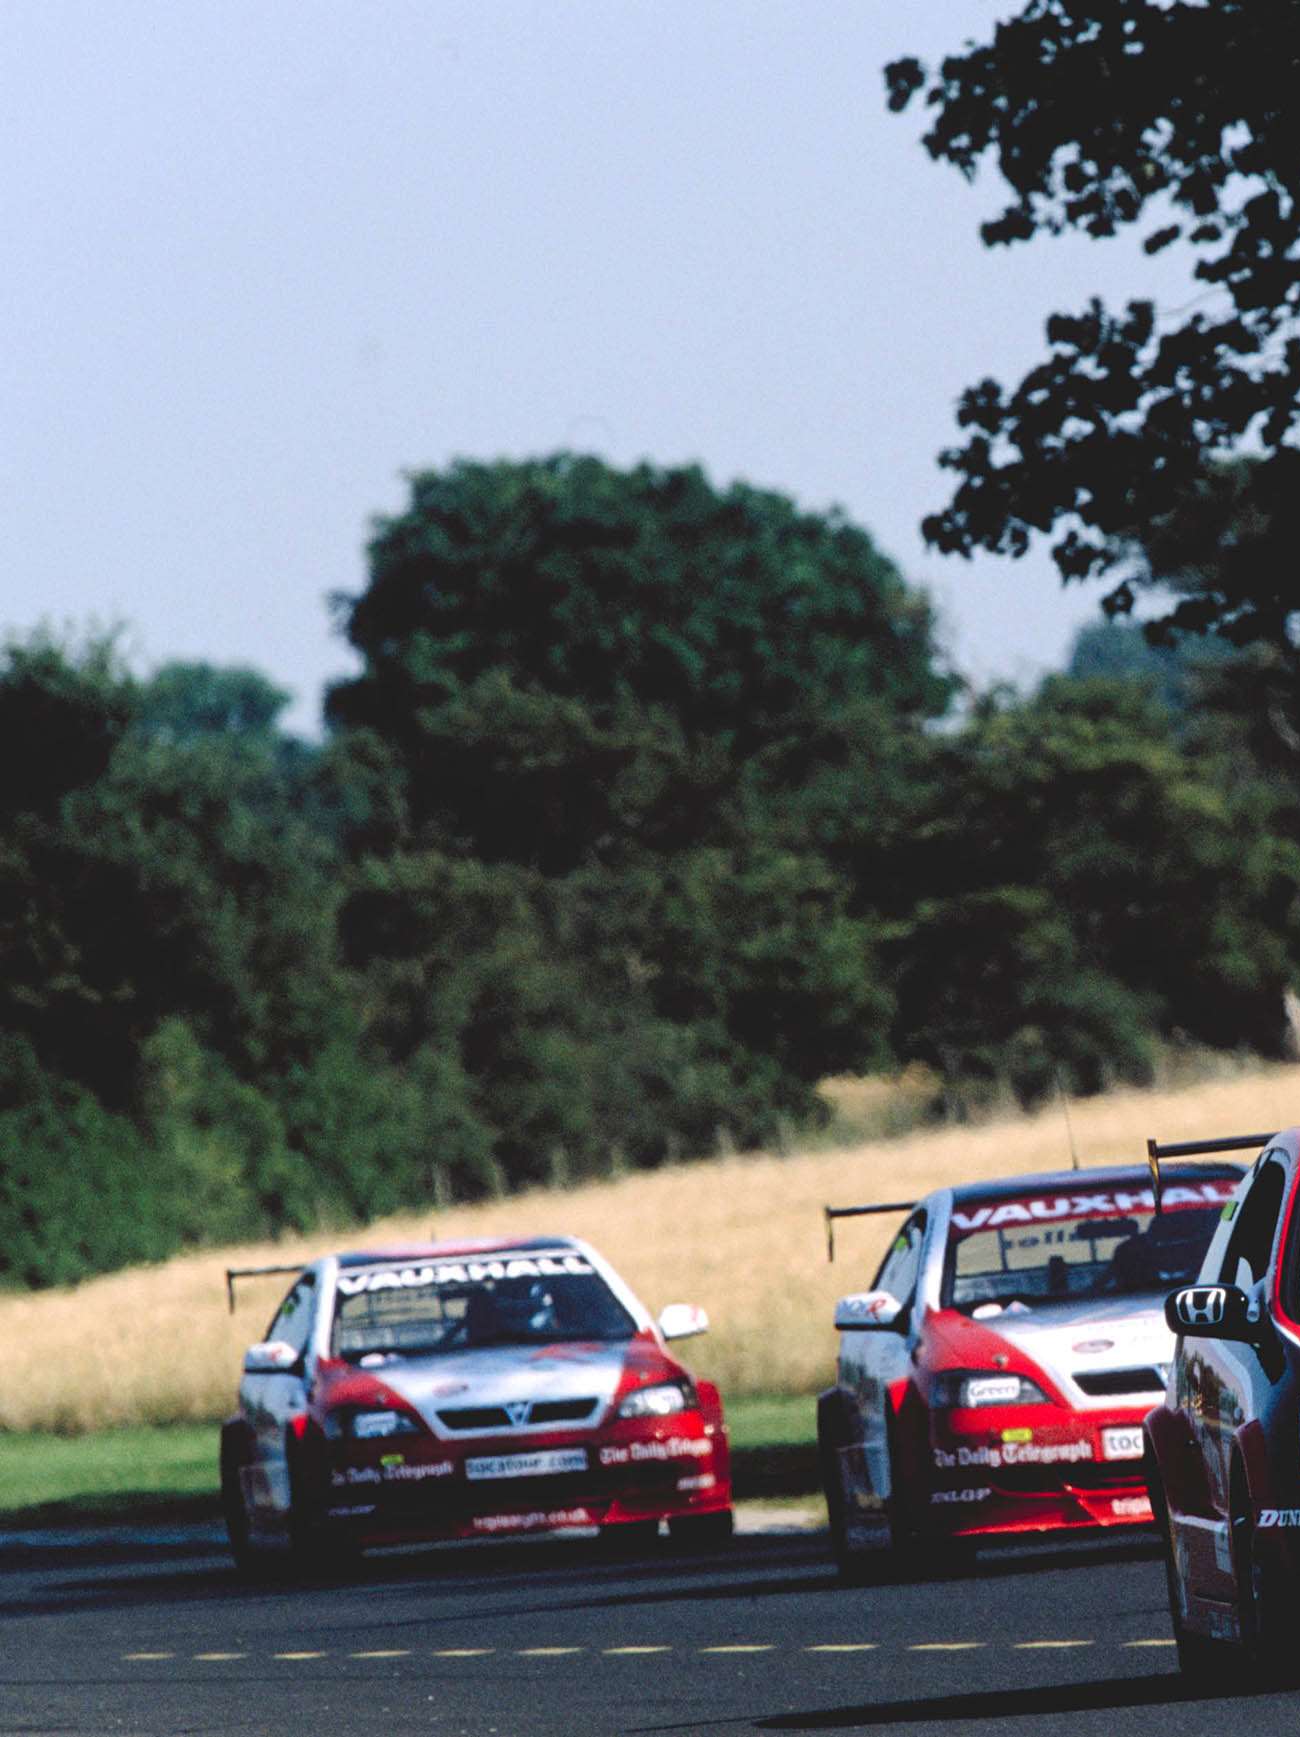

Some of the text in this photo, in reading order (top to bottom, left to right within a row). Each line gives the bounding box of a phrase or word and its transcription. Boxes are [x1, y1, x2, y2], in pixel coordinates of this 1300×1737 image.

[951, 1182, 1239, 1230] VAUXHAL
[337, 1256, 594, 1295] VAUXHALL
[970, 1382, 1017, 1397] Green
[958, 1446, 1001, 1468] Daily
[1002, 1439, 1092, 1465] Telegraph
